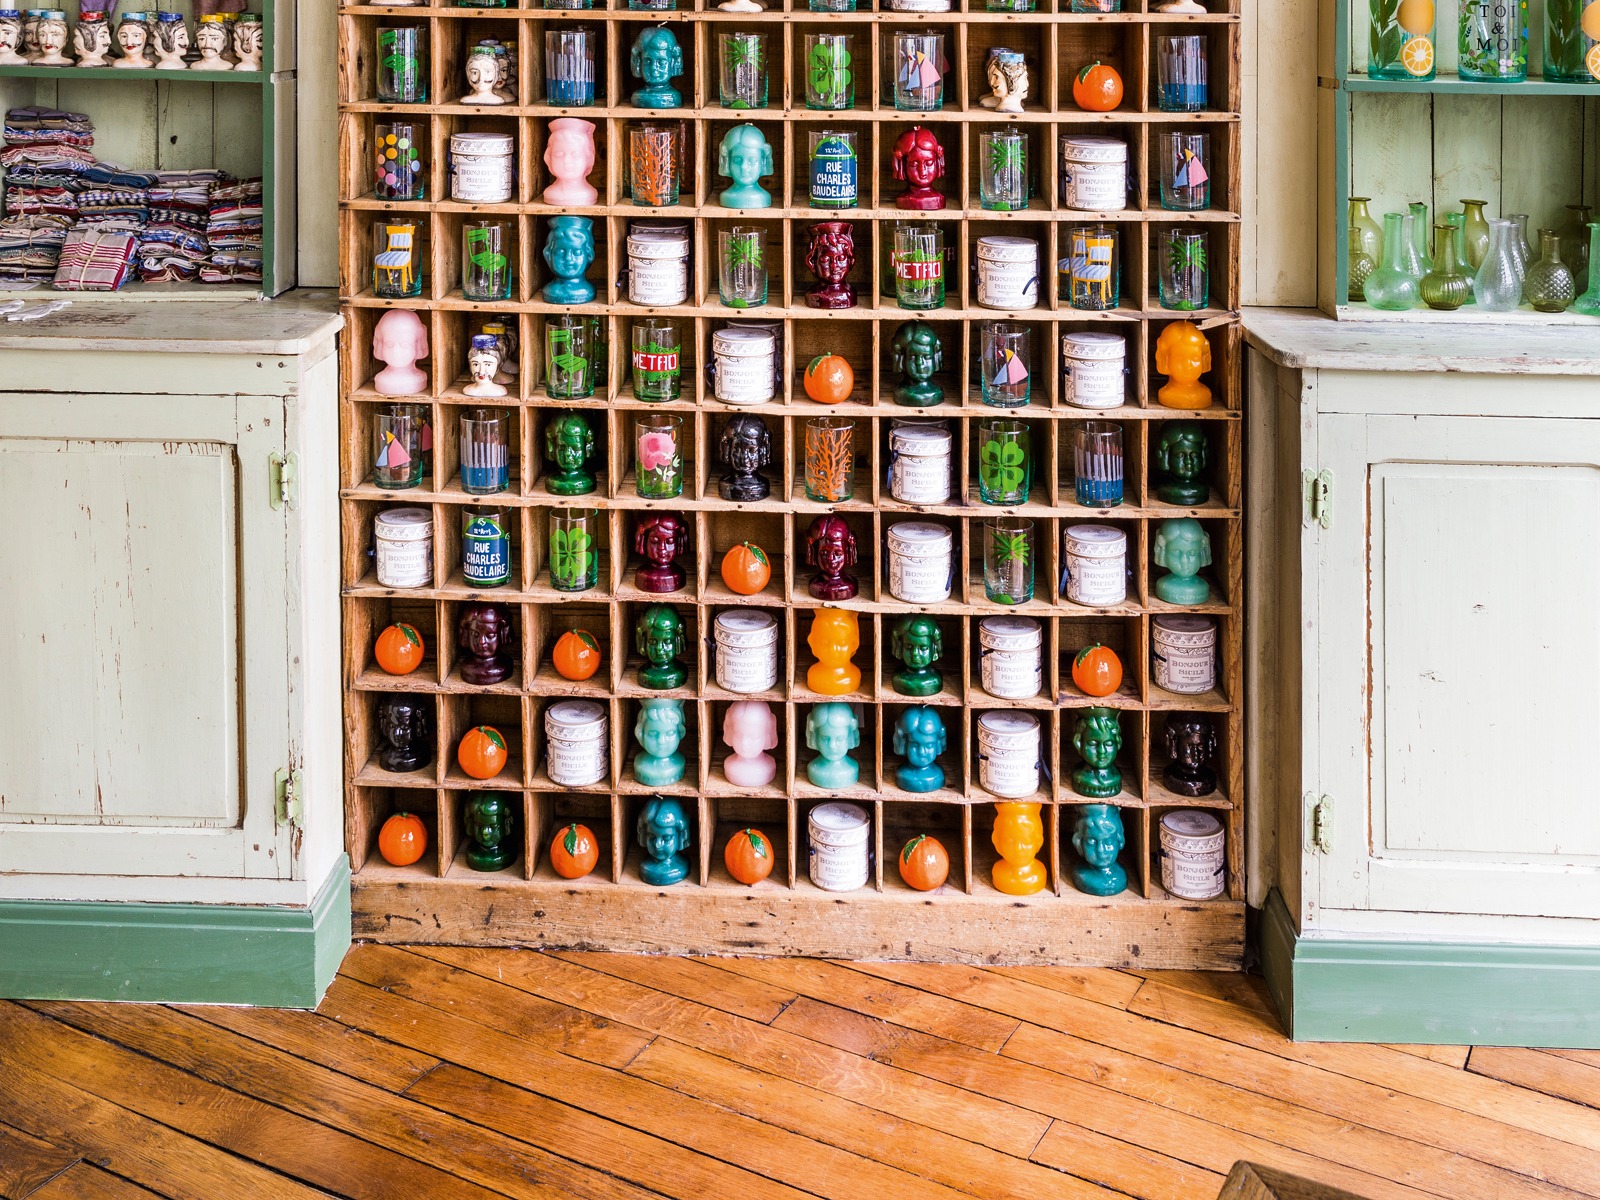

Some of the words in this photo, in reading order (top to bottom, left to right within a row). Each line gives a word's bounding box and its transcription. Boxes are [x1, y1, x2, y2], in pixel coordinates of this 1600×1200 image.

[1479, 4, 1516, 18] TOI
[1491, 21, 1505, 35] &
[1476, 37, 1518, 51] MOI
[825, 161, 843, 173] RUE
[816, 173, 852, 185] CHARLES
[812, 184, 856, 197] BAUDELAIRE
[474, 542, 490, 554] RUE
[466, 552, 501, 566] CHARLES
[1083, 571, 1120, 579] BONJOUR
[1172, 660, 1209, 668] BONJOUR
[1176, 864, 1215, 874] BONJOUR
